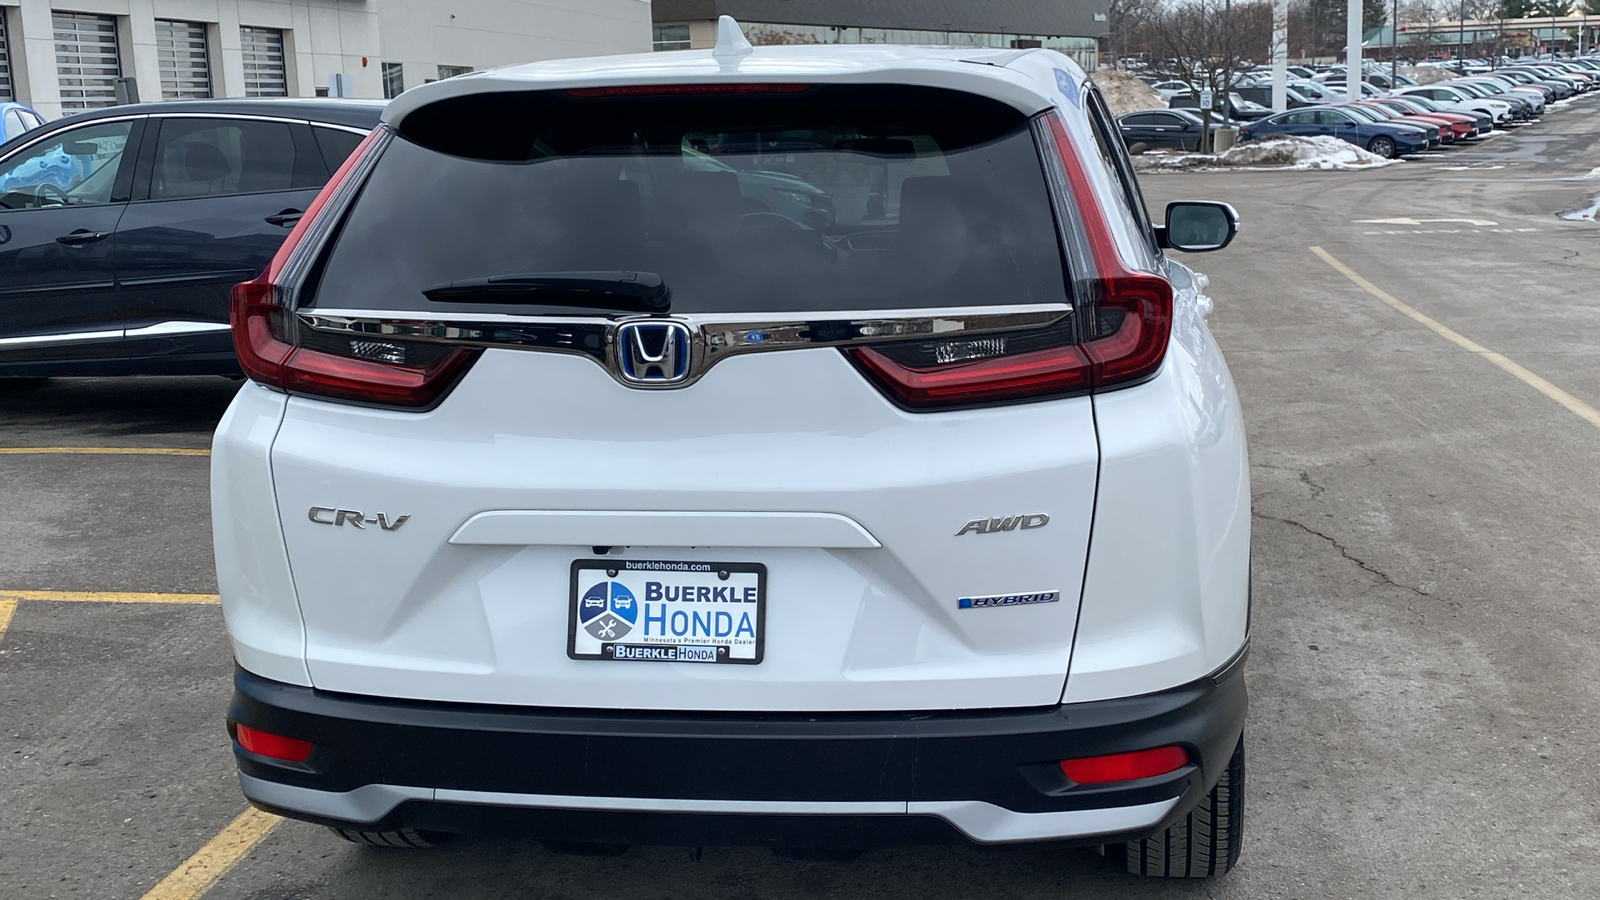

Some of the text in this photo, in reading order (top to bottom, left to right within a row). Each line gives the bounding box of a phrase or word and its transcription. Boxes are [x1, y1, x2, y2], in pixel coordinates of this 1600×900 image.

[308, 506, 411, 531] CR-V
[954, 512, 1050, 536] AWD
[626, 561, 711, 571] buerklehonda.com
[645, 581, 756, 603] BUERKLE
[973, 592, 1054, 607] HYBRID
[643, 603, 755, 637] HONDA
[683, 637, 710, 645] Premier
[615, 645, 715, 661] BUERKLE HONDA
